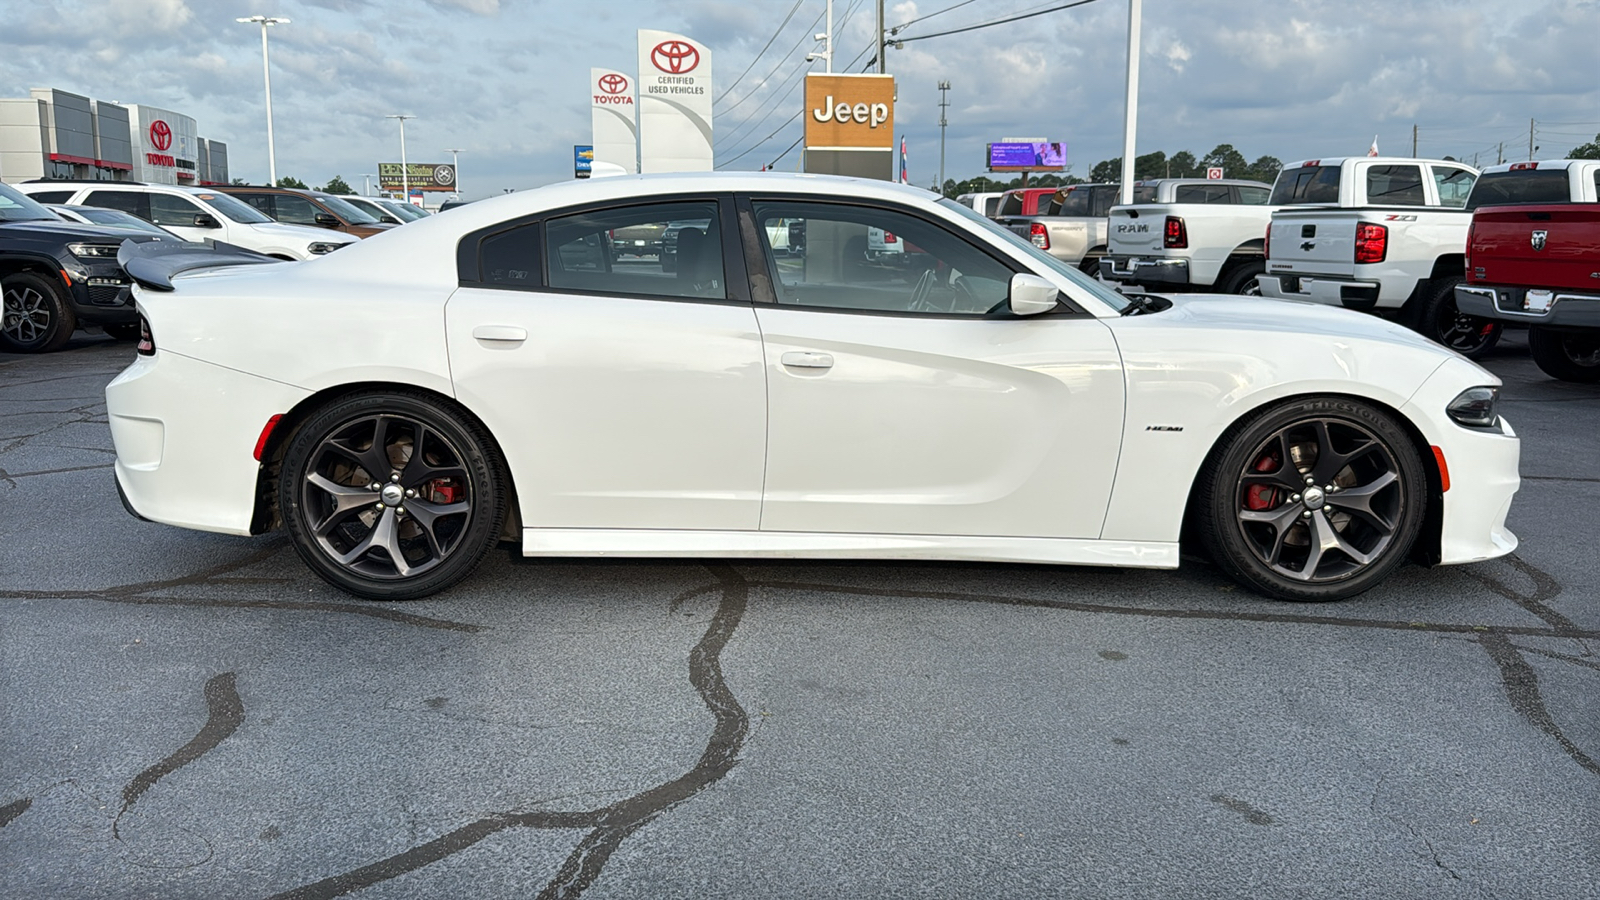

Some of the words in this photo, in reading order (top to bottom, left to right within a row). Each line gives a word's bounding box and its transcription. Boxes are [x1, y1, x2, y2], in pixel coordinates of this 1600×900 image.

[657, 76, 694, 85] CERTIFIED
[648, 85, 669, 94] USED
[670, 86, 704, 95] VEHICLES
[593, 95, 634, 105] TOYOTA
[813, 95, 888, 128] Jeep
[146, 153, 175, 167] TOYOTA
[1117, 224, 1149, 233] RAM
